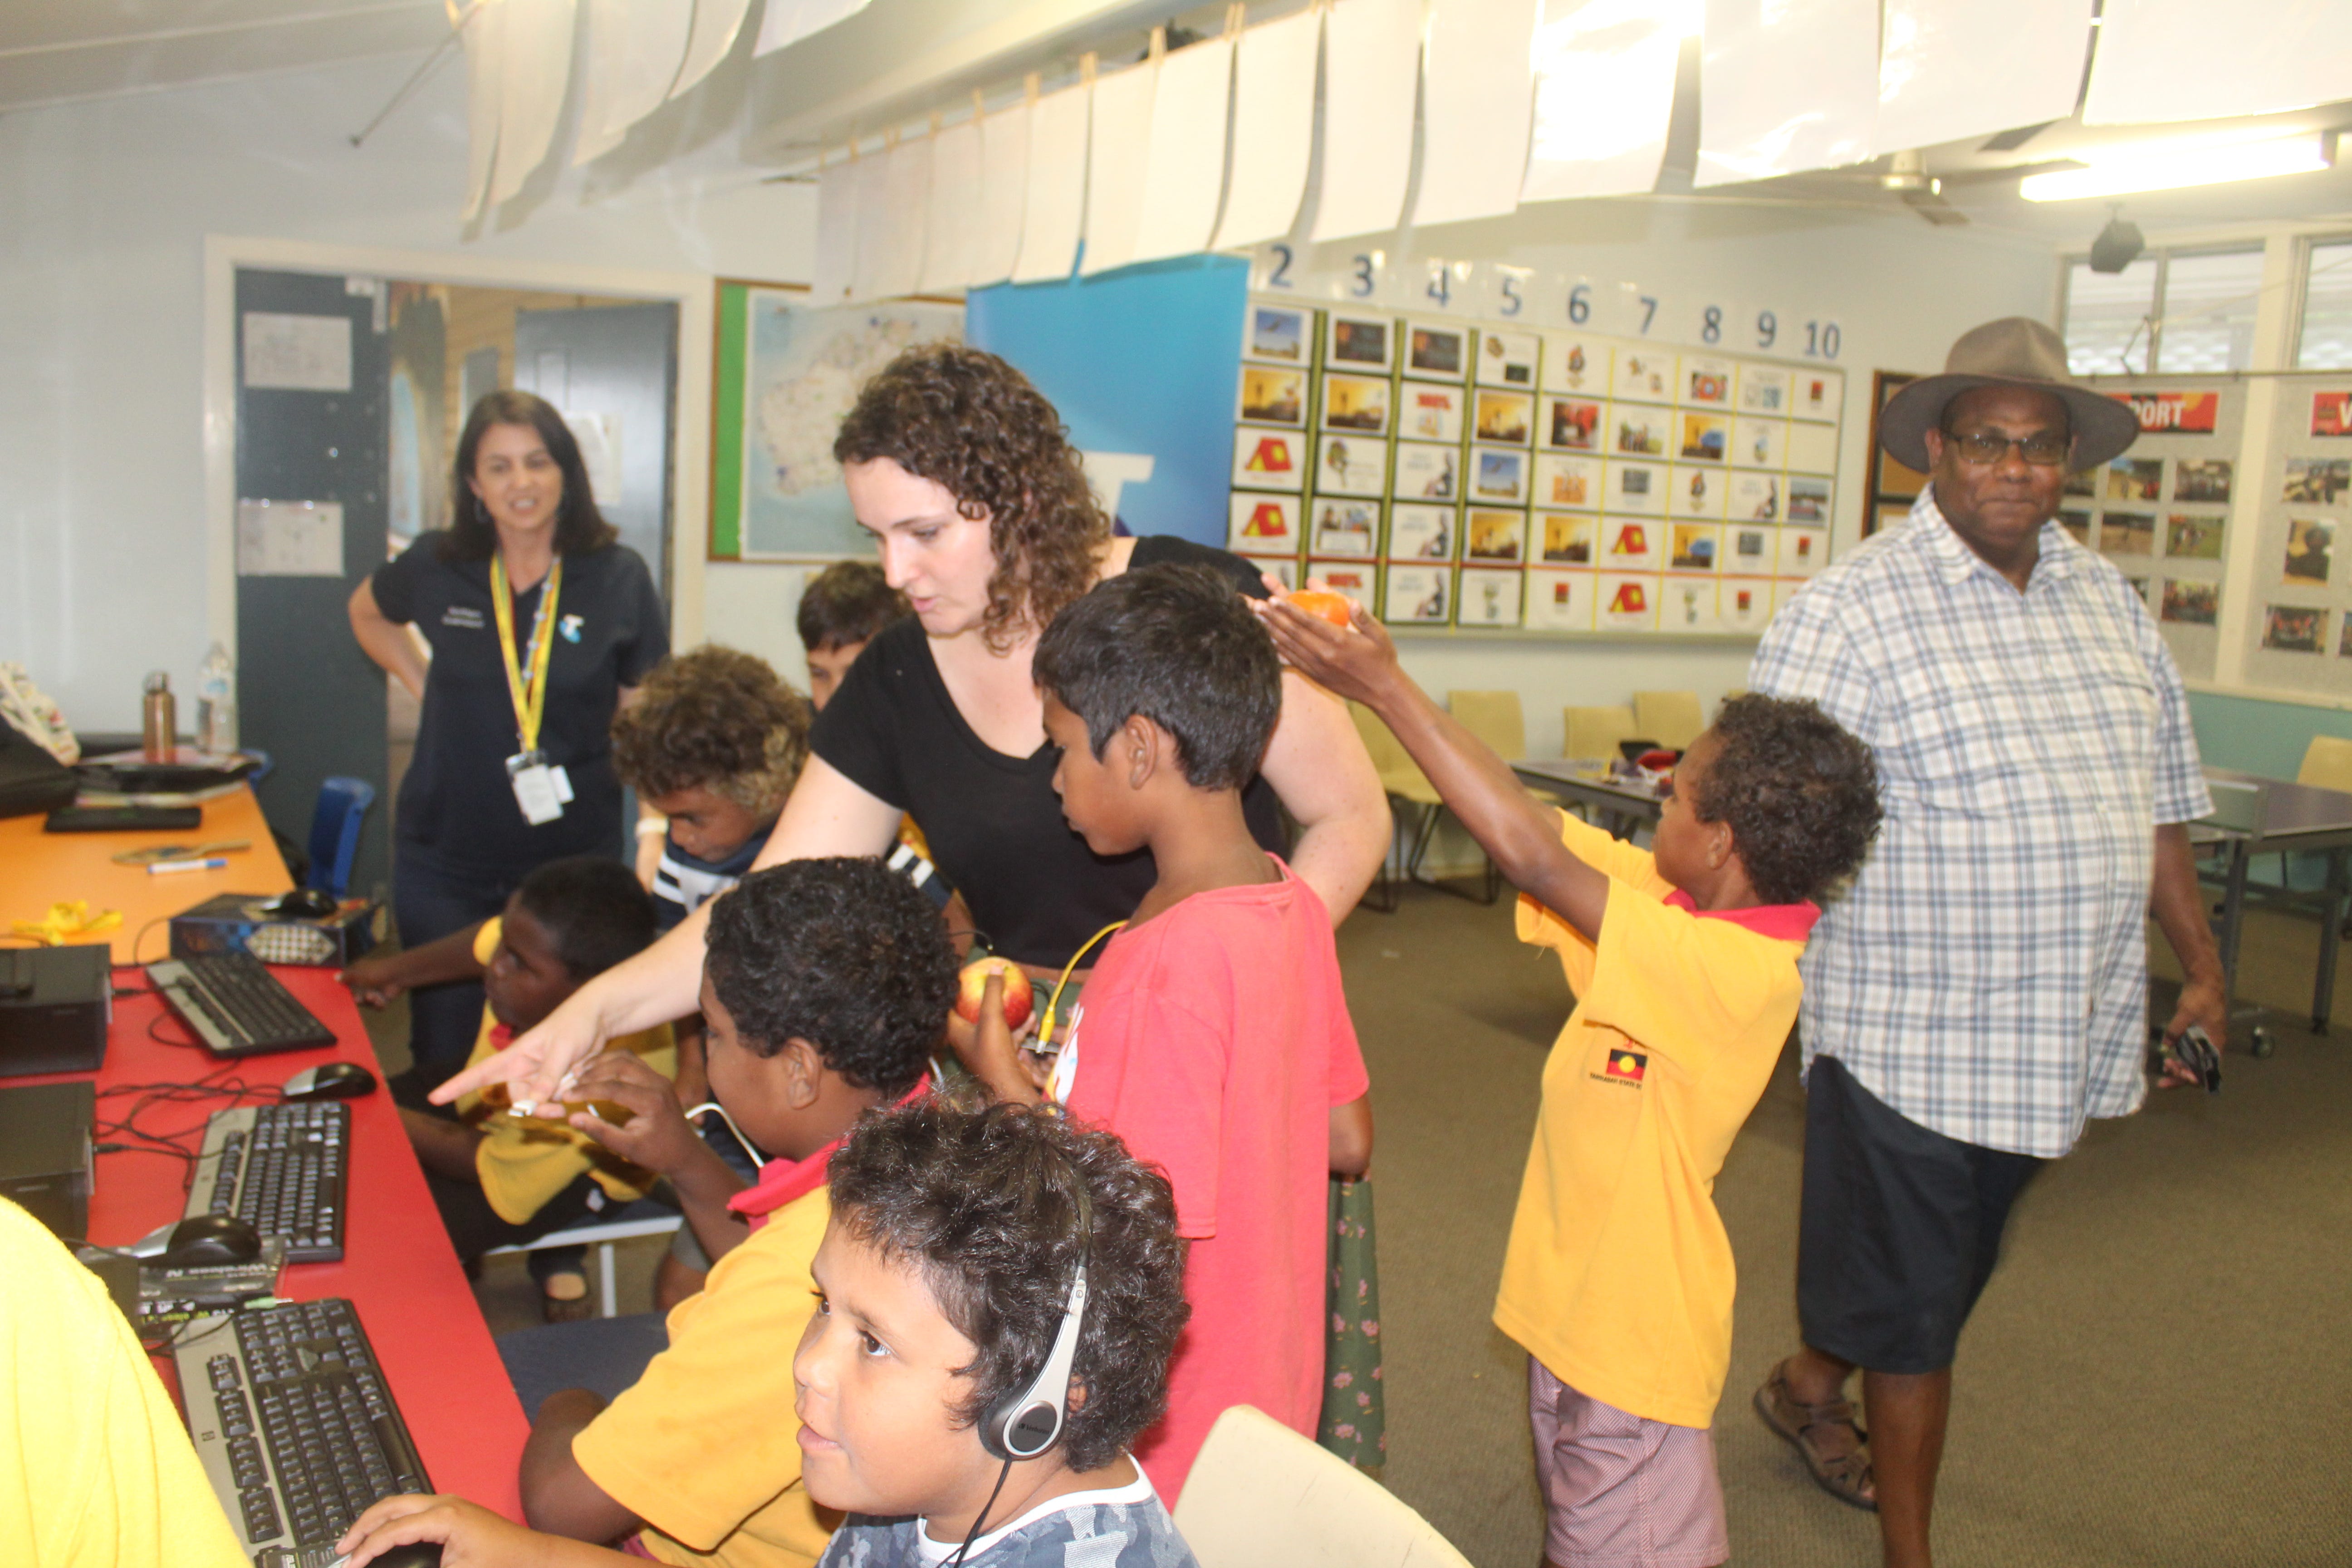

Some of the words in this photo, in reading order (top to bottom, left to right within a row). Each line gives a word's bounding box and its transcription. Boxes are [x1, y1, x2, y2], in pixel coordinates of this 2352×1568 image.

[1271, 243, 1294, 288] 2
[1351, 254, 1374, 297] 3
[1426, 266, 1450, 306] 4
[1500, 275, 1523, 316] 5
[1568, 284, 1591, 324] 6
[1640, 295, 1658, 334] 7
[1701, 304, 1722, 344] 8
[1756, 310, 1777, 348] 9
[1804, 320, 1841, 359] 10
